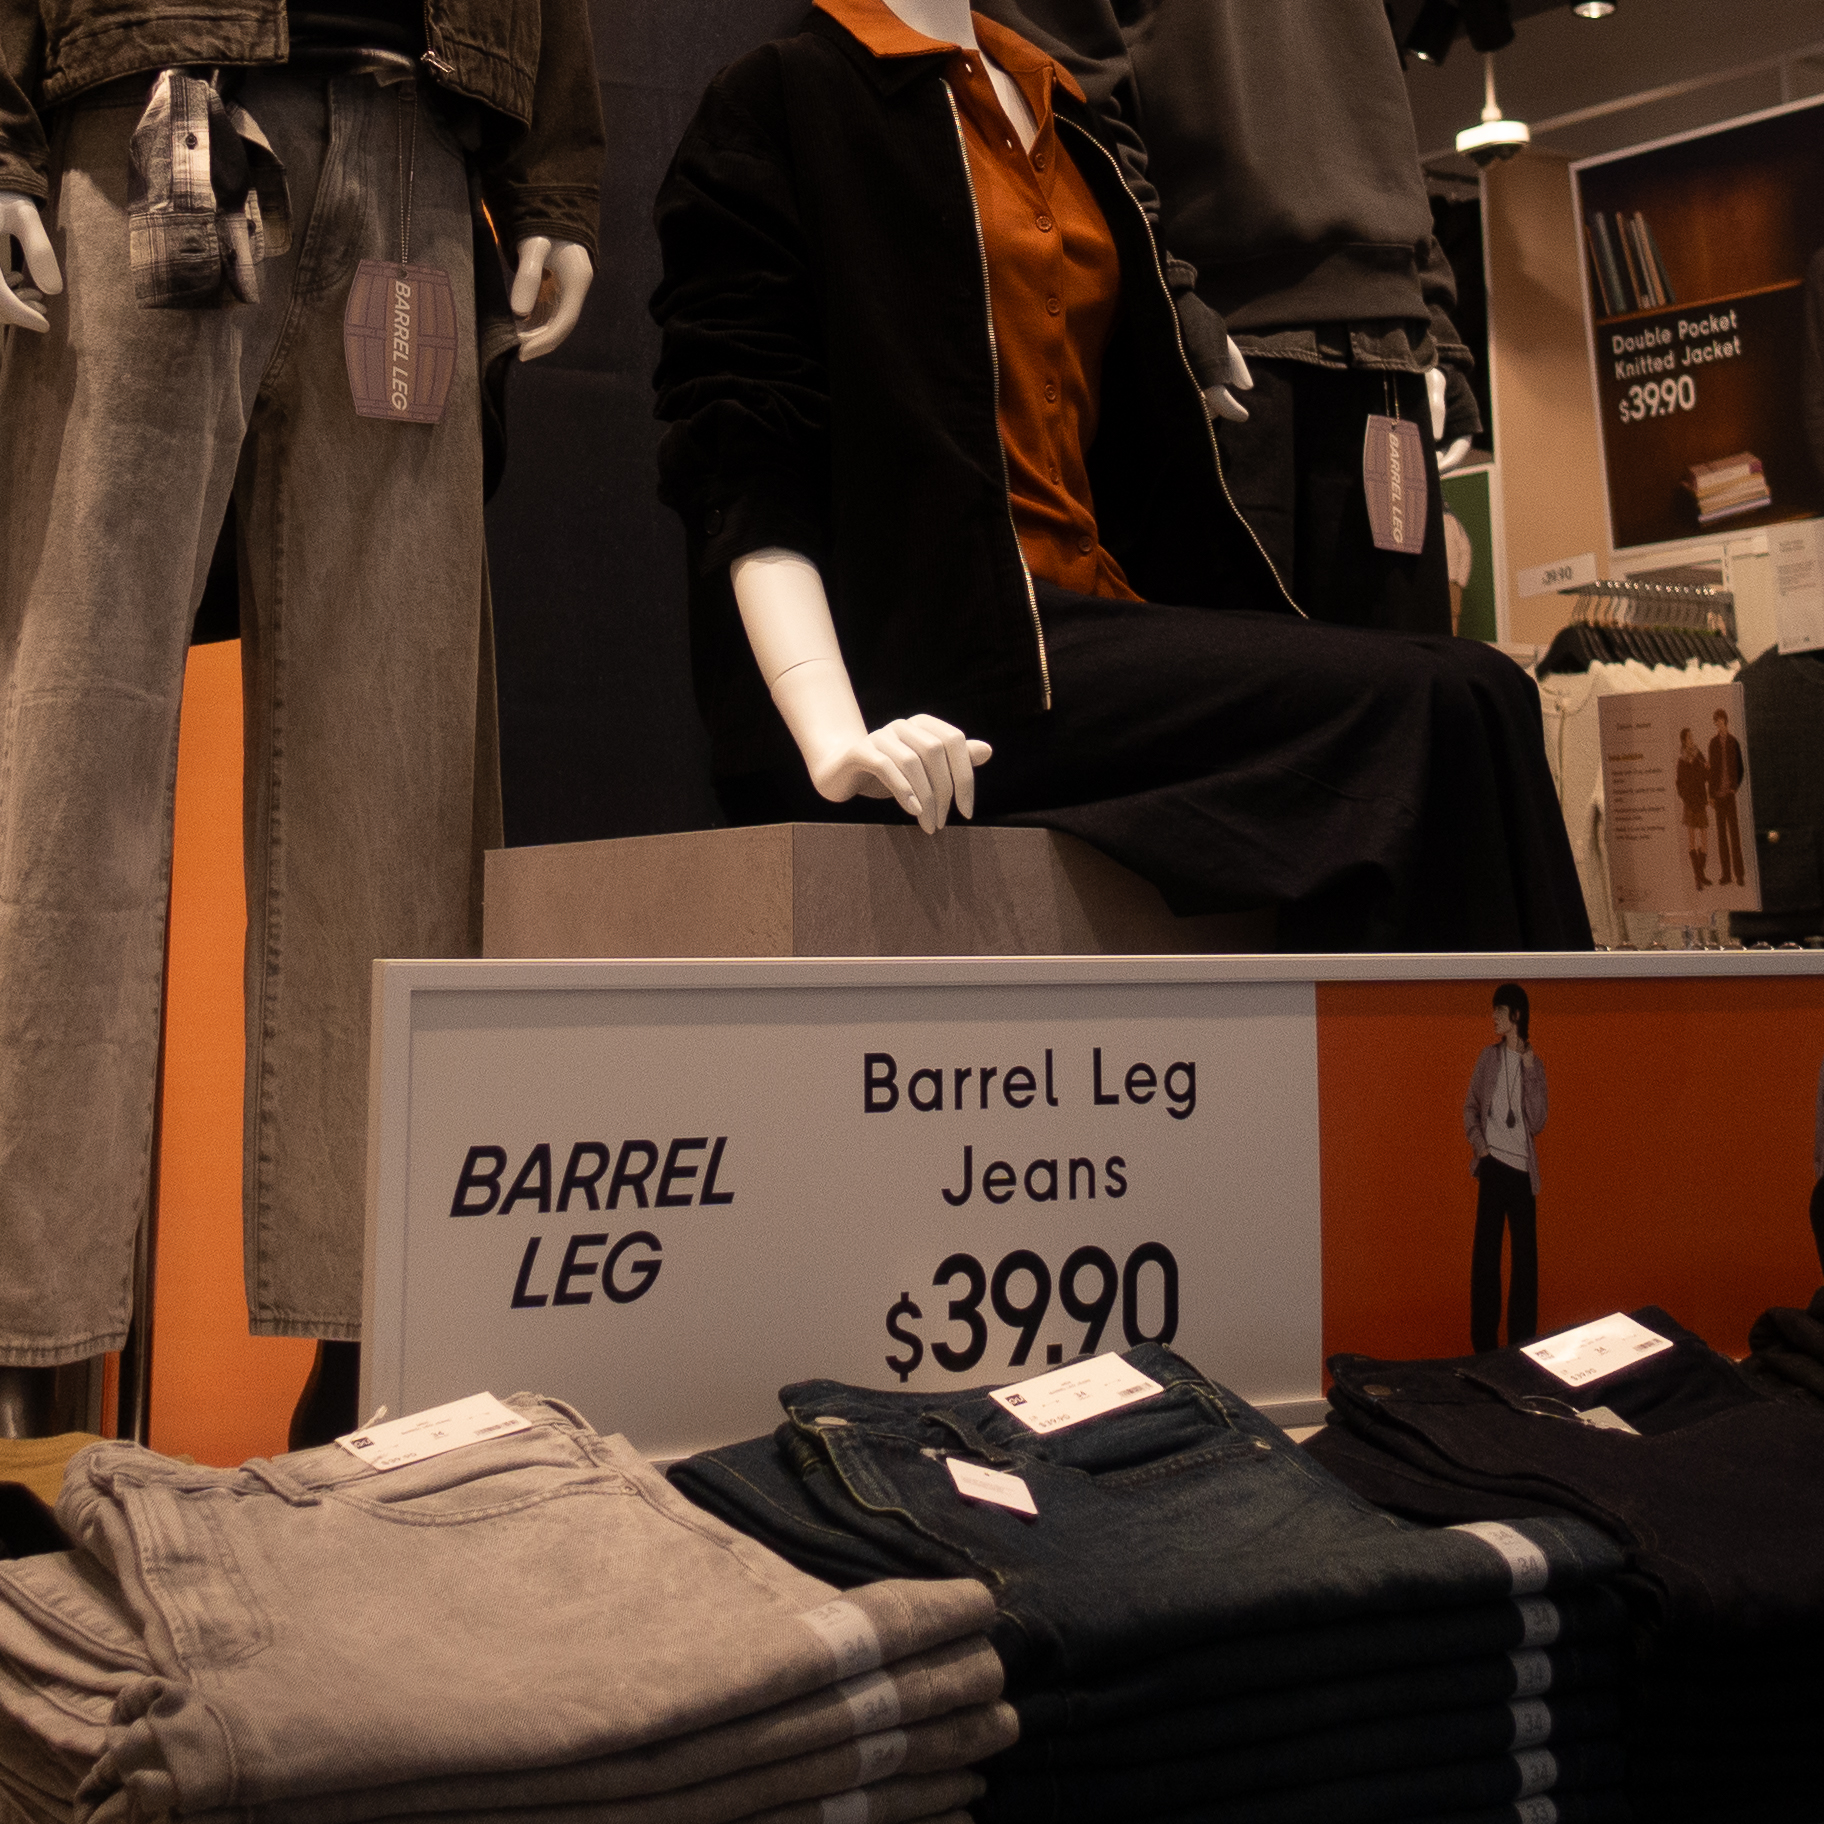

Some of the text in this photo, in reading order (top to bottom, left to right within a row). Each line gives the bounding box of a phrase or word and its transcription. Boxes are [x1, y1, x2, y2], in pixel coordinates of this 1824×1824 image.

[391, 280, 411, 411] BARREL LEG
[1612, 309, 1737, 355] Double Pocket
[1615, 335, 1741, 381] Knitted Jacket
[1619, 374, 1696, 424] $39.90
[1388, 432, 1404, 544] BARREL LEG
[864, 1047, 1198, 1120] Barrel Leg
[449, 1136, 736, 1219] BARREL
[942, 1145, 1128, 1207] Jeans
[510, 1231, 663, 1309] LEG
[885, 1241, 1180, 1382] $39.90
